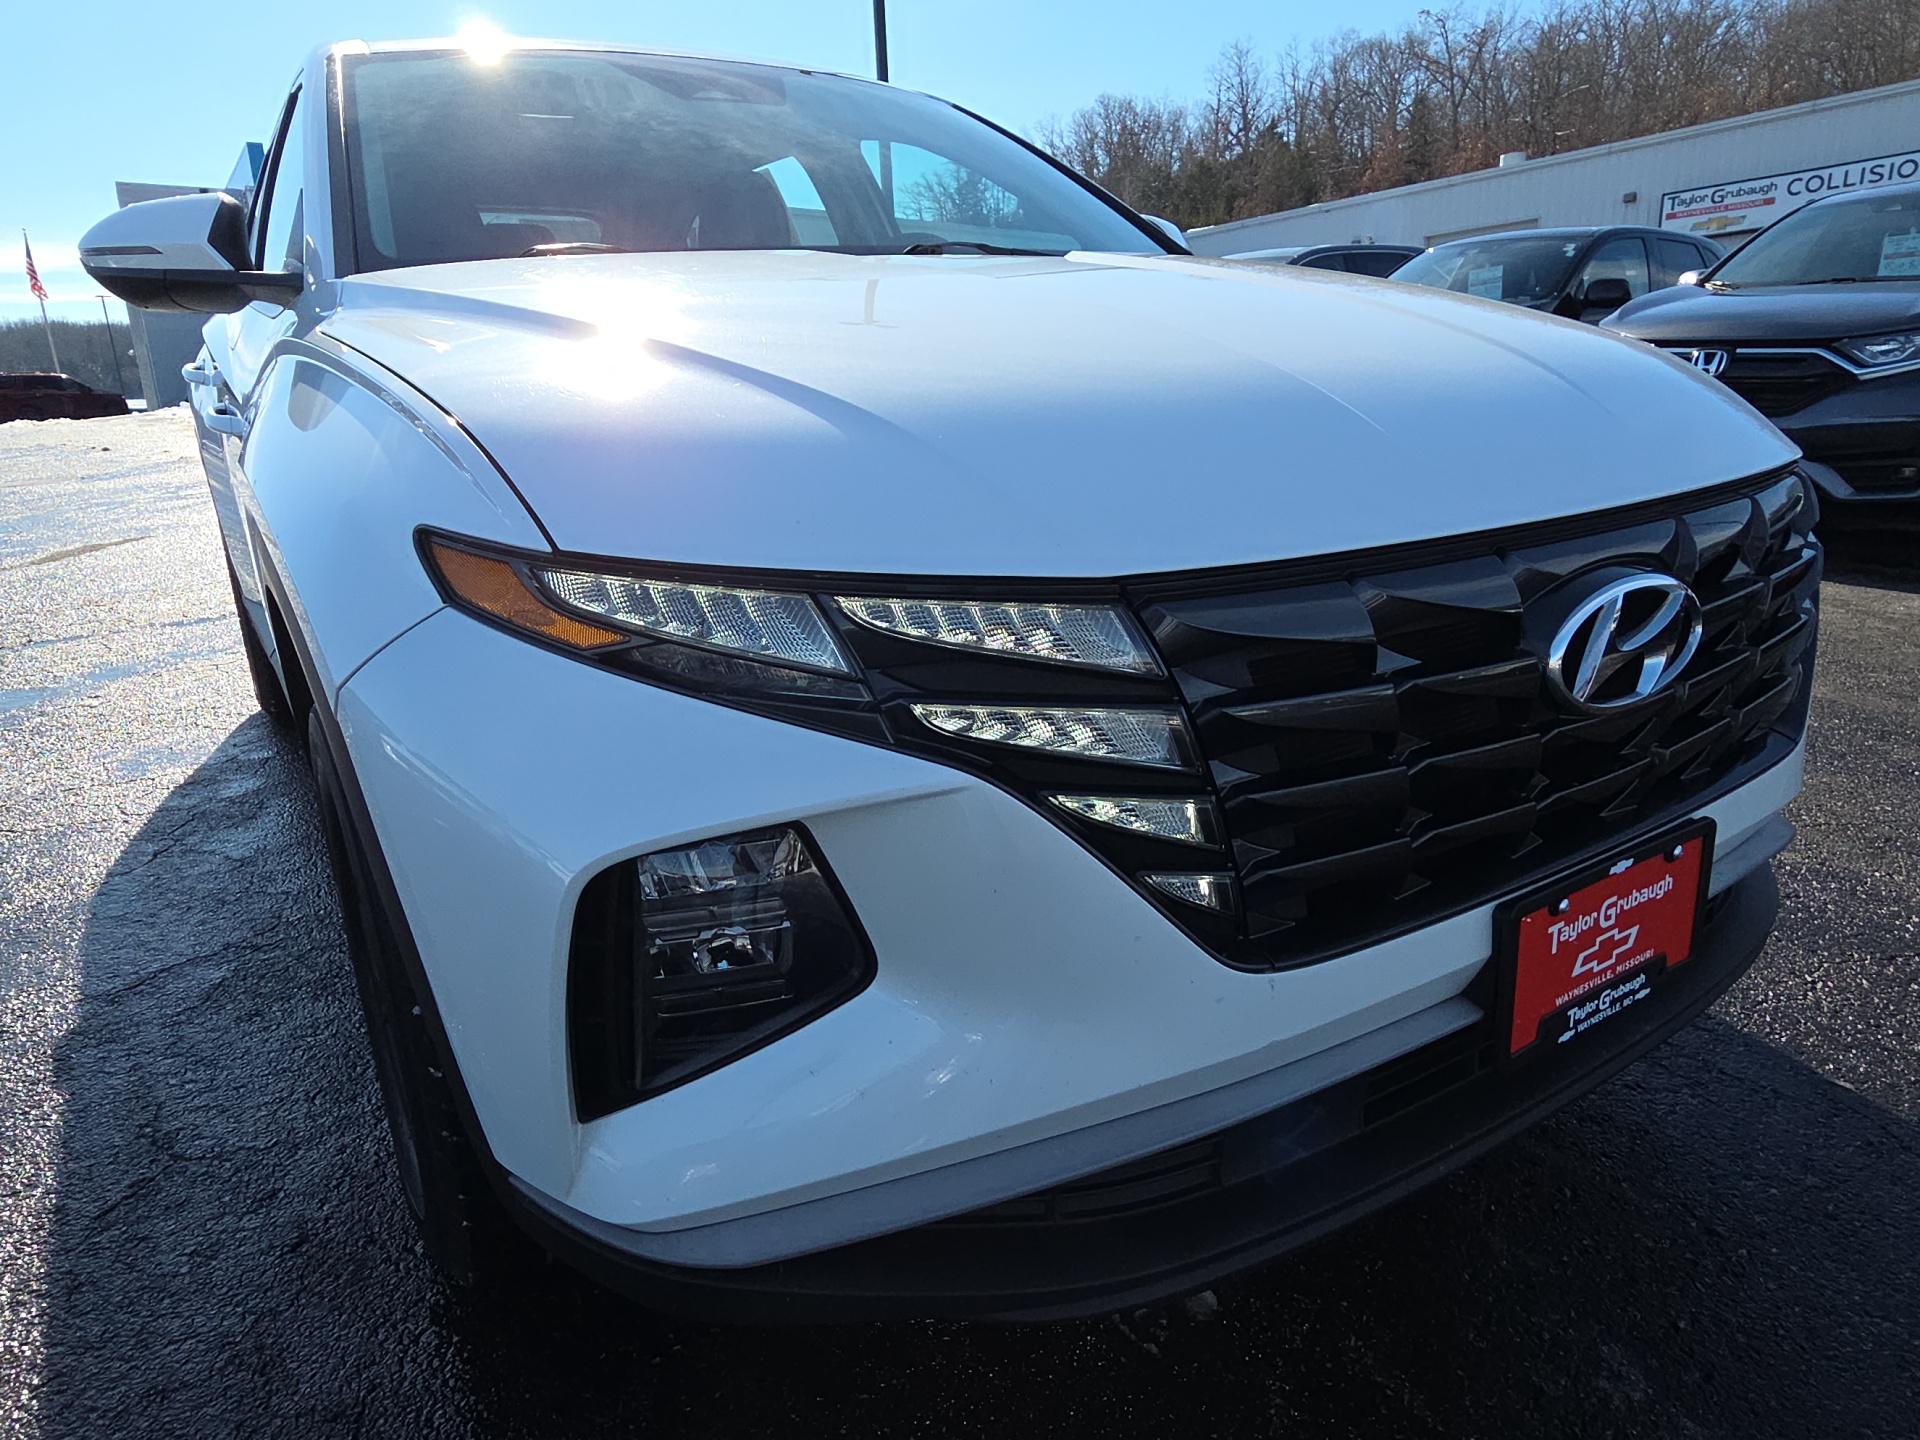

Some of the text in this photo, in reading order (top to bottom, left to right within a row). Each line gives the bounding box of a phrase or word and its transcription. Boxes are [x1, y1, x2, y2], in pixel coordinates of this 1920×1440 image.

[1668, 181, 1778, 211] Taylor Grubaugh
[1787, 158, 1919, 196] COLLISIO
[1548, 874, 1673, 954] Taylor Grubaugh
[1555, 948, 1654, 1007] WAYNESVILLE, MISSOURI
[1567, 973, 1646, 1027] Taylor Grubaugh
